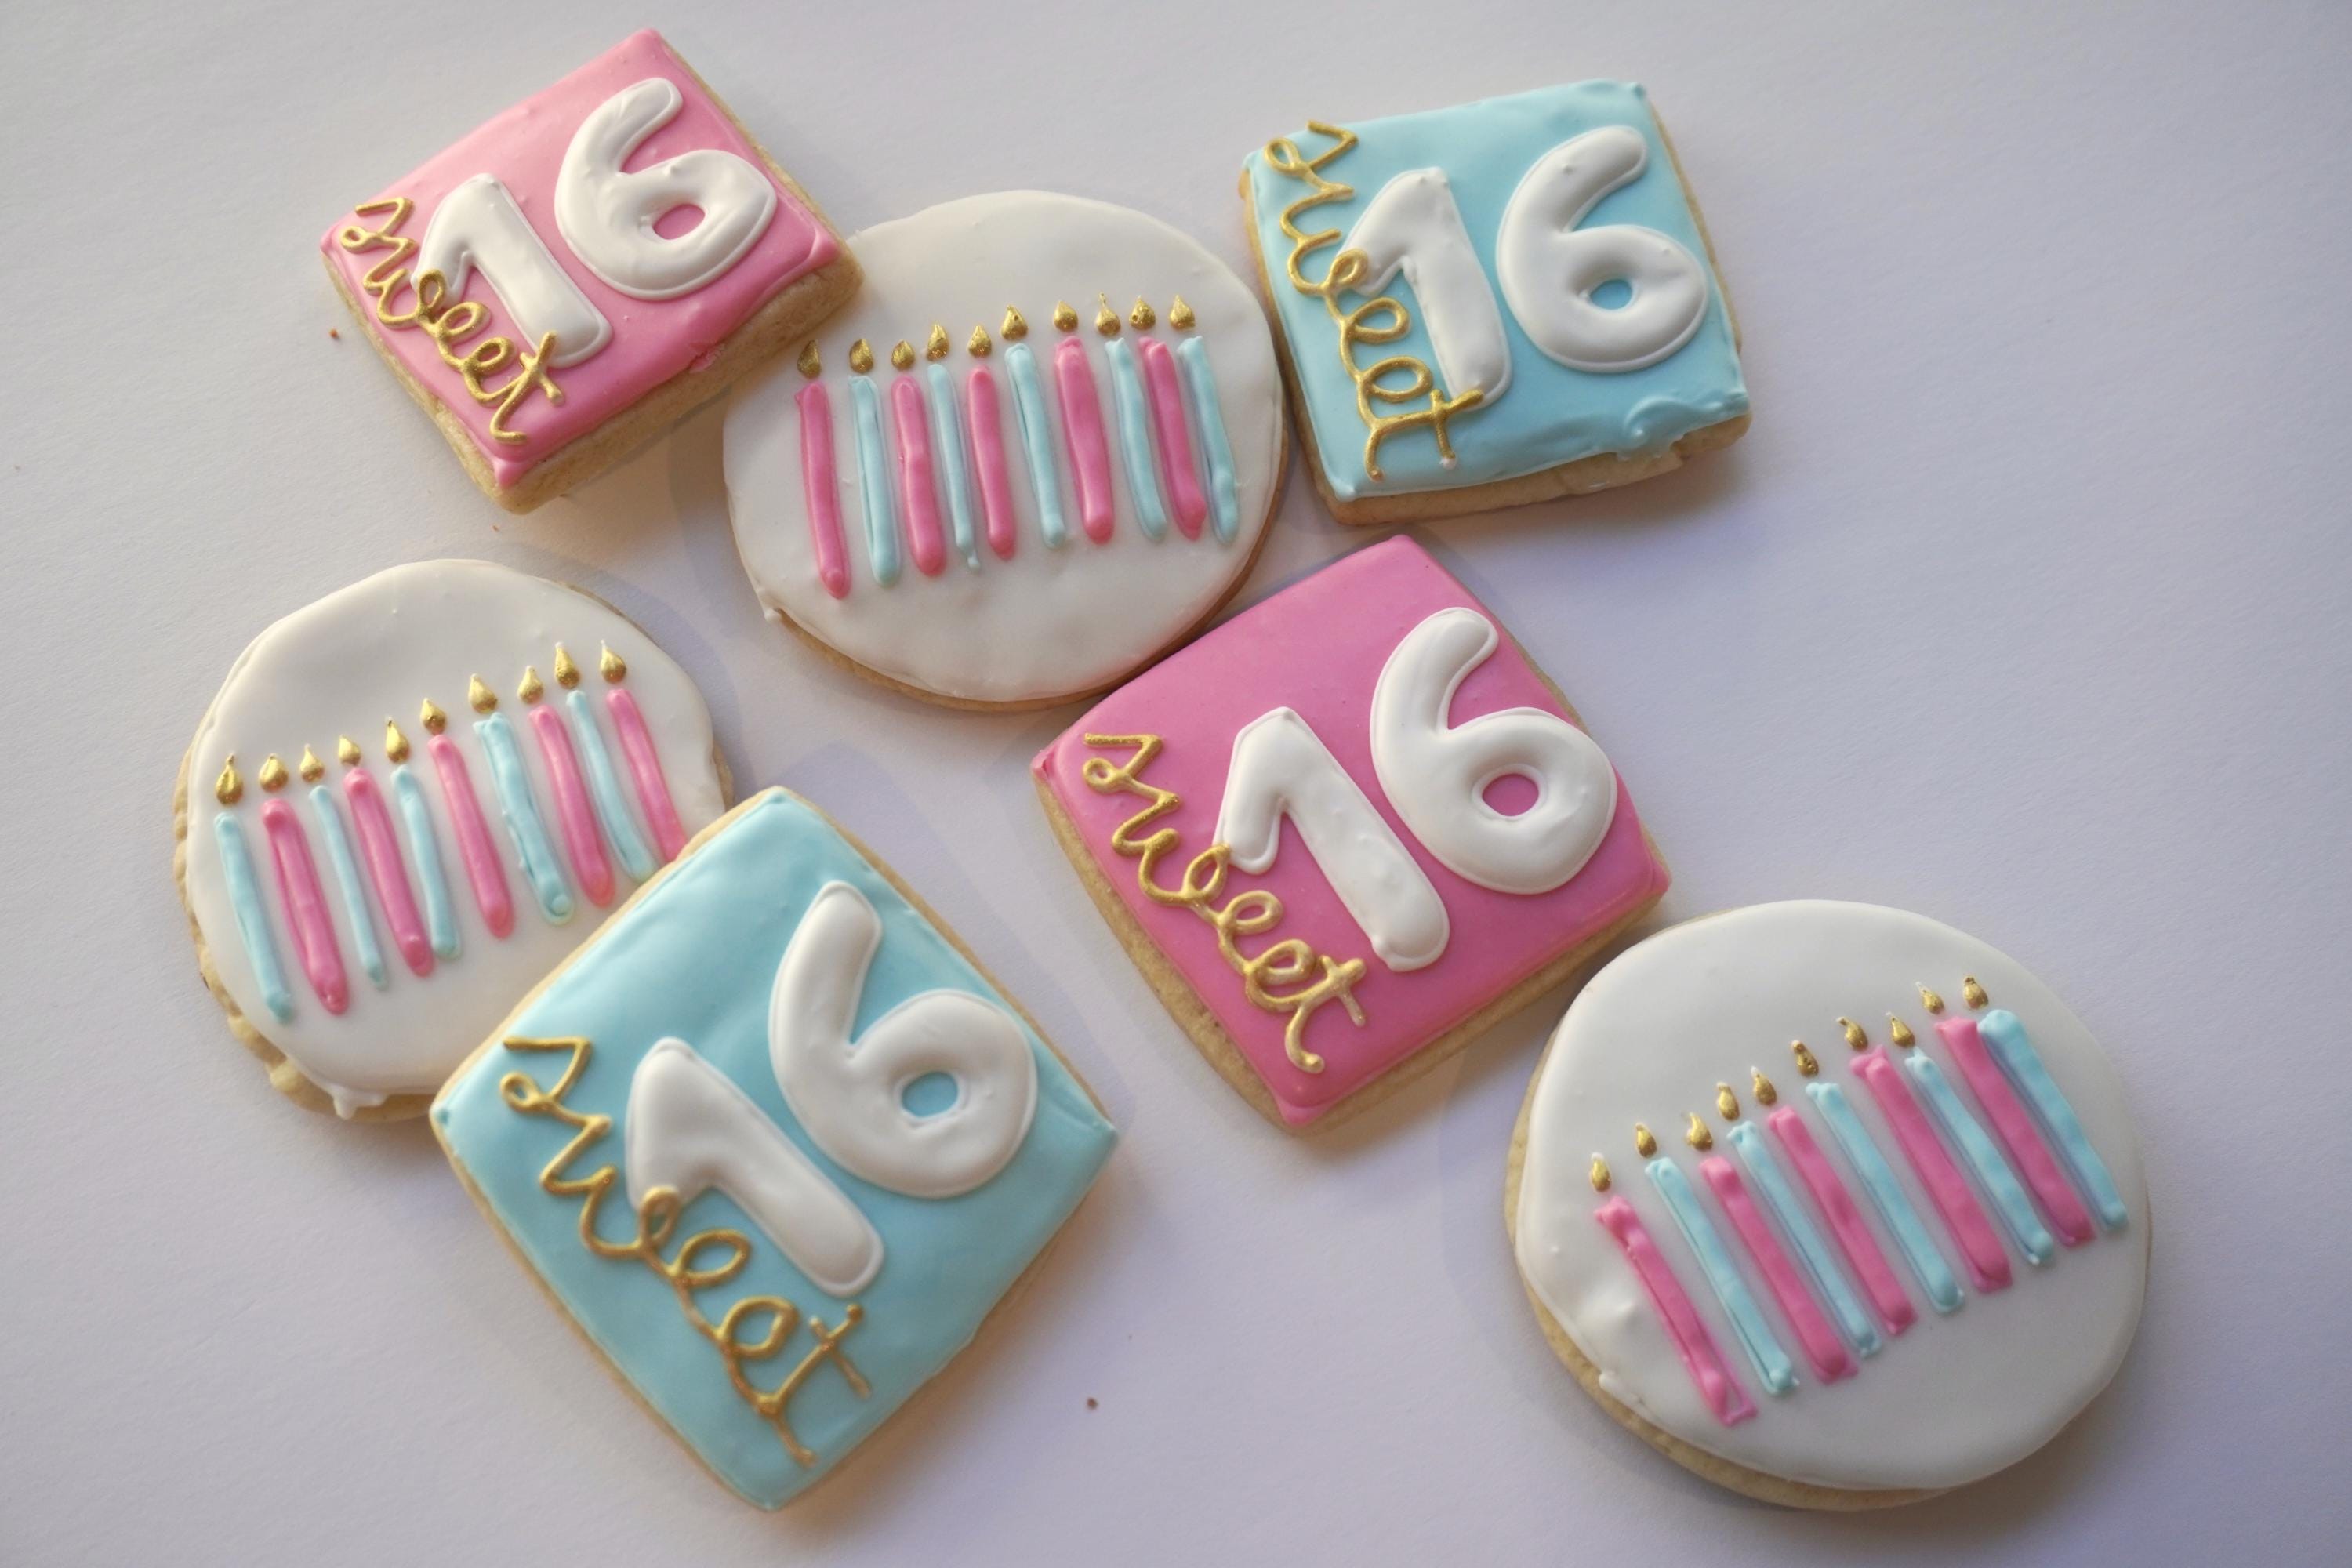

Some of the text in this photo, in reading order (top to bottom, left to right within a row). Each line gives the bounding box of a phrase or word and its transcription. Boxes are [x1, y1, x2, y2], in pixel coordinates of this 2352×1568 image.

[339, 197, 564, 445] sweet
[410, 78, 777, 368] 16
[1265, 119, 1485, 483] sweet
[1333, 125, 1709, 412] 16
[1082, 732, 1367, 1074] sweet
[1212, 607, 1618, 973] 16
[499, 1036, 872, 1468] sweet
[626, 880, 1038, 1298] 16
